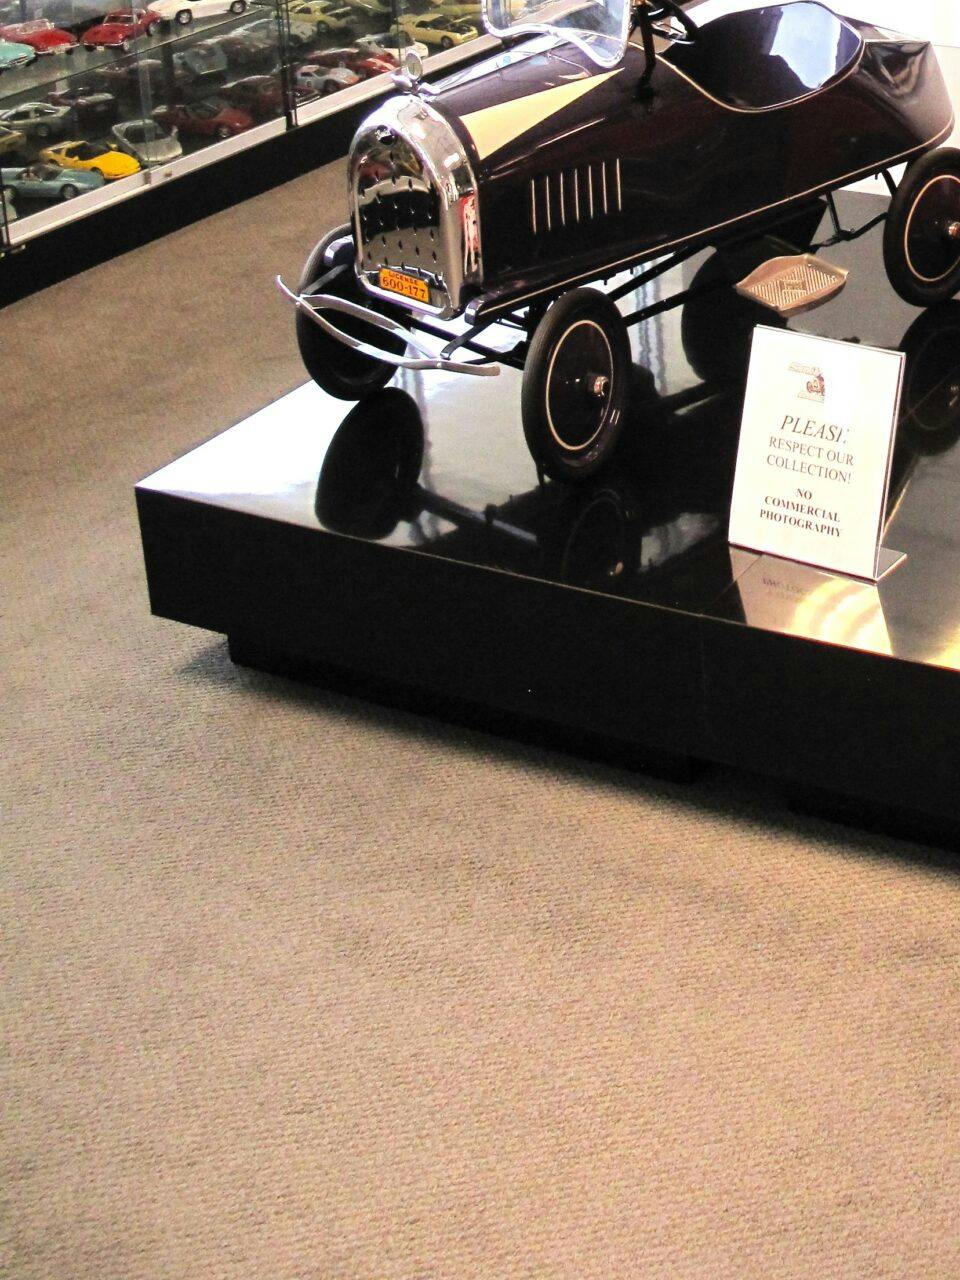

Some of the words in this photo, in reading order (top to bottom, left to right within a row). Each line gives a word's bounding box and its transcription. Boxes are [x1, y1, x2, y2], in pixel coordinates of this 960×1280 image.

[382, 276, 426, 298] 600-177
[769, 436, 823, 458] RESPECT
[827, 450, 854, 466] OUR
[767, 454, 852, 484] COLLECTION!
[797, 488, 813, 500] NO
[765, 495, 841, 522] COMMERCIAL
[759, 509, 842, 538] PHOTOGRAPHY
